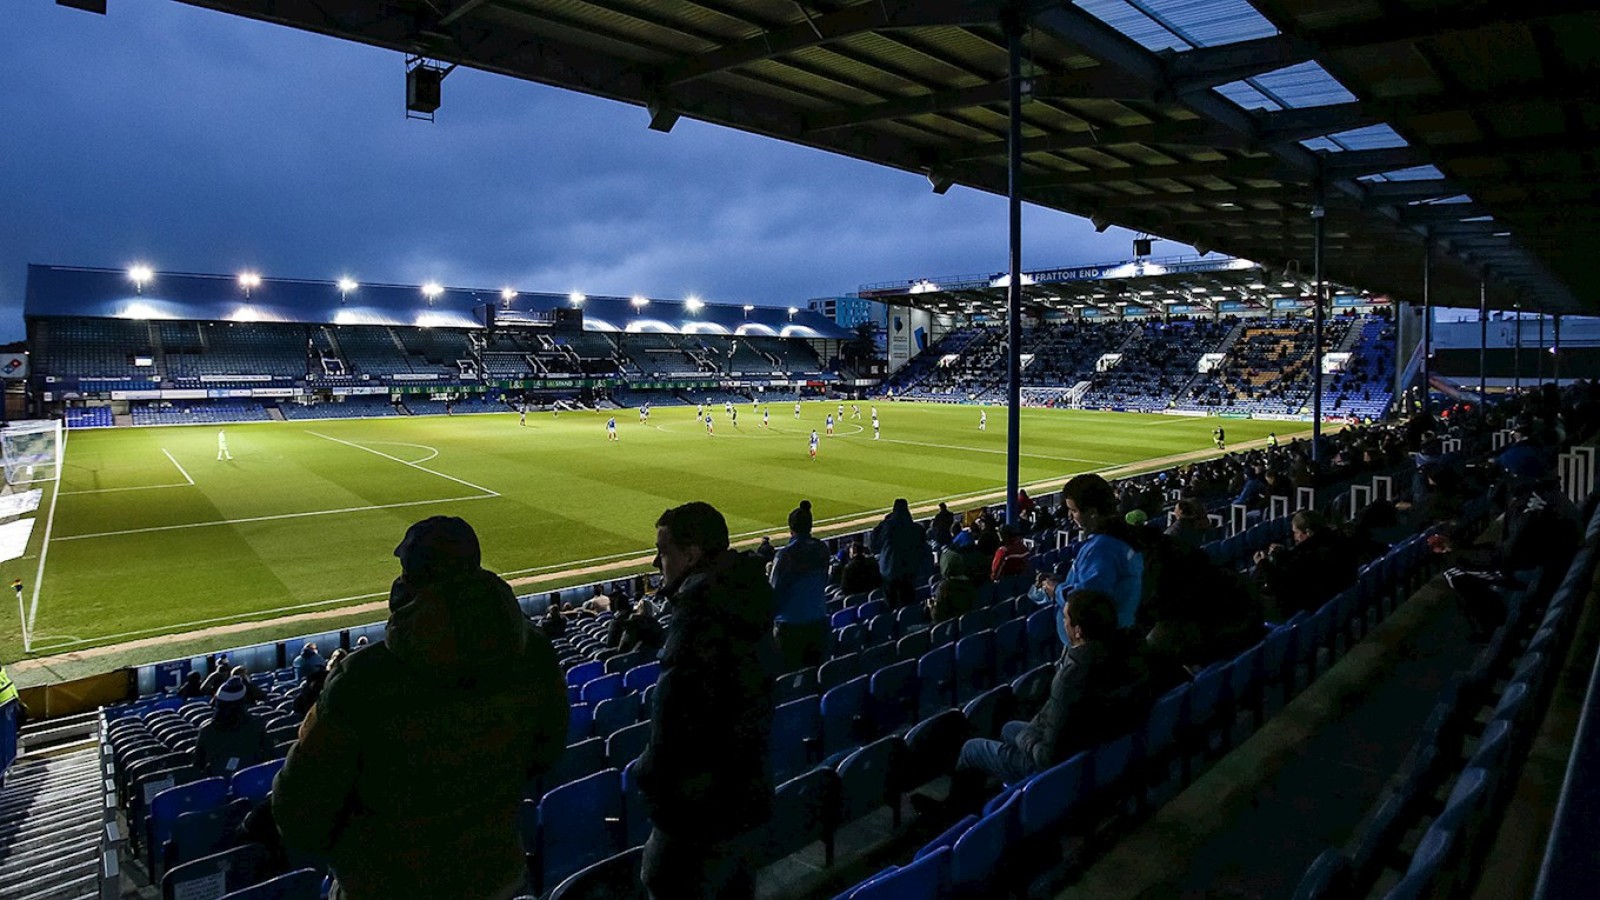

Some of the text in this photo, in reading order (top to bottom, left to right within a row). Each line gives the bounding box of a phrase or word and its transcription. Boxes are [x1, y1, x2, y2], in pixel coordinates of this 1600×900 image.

[1035, 270, 1077, 282] FRATTON
[1079, 268, 1100, 278] END
[508, 379, 524, 389] L&S
[391, 386, 404, 394] L&S
[408, 386, 421, 394] L&S
